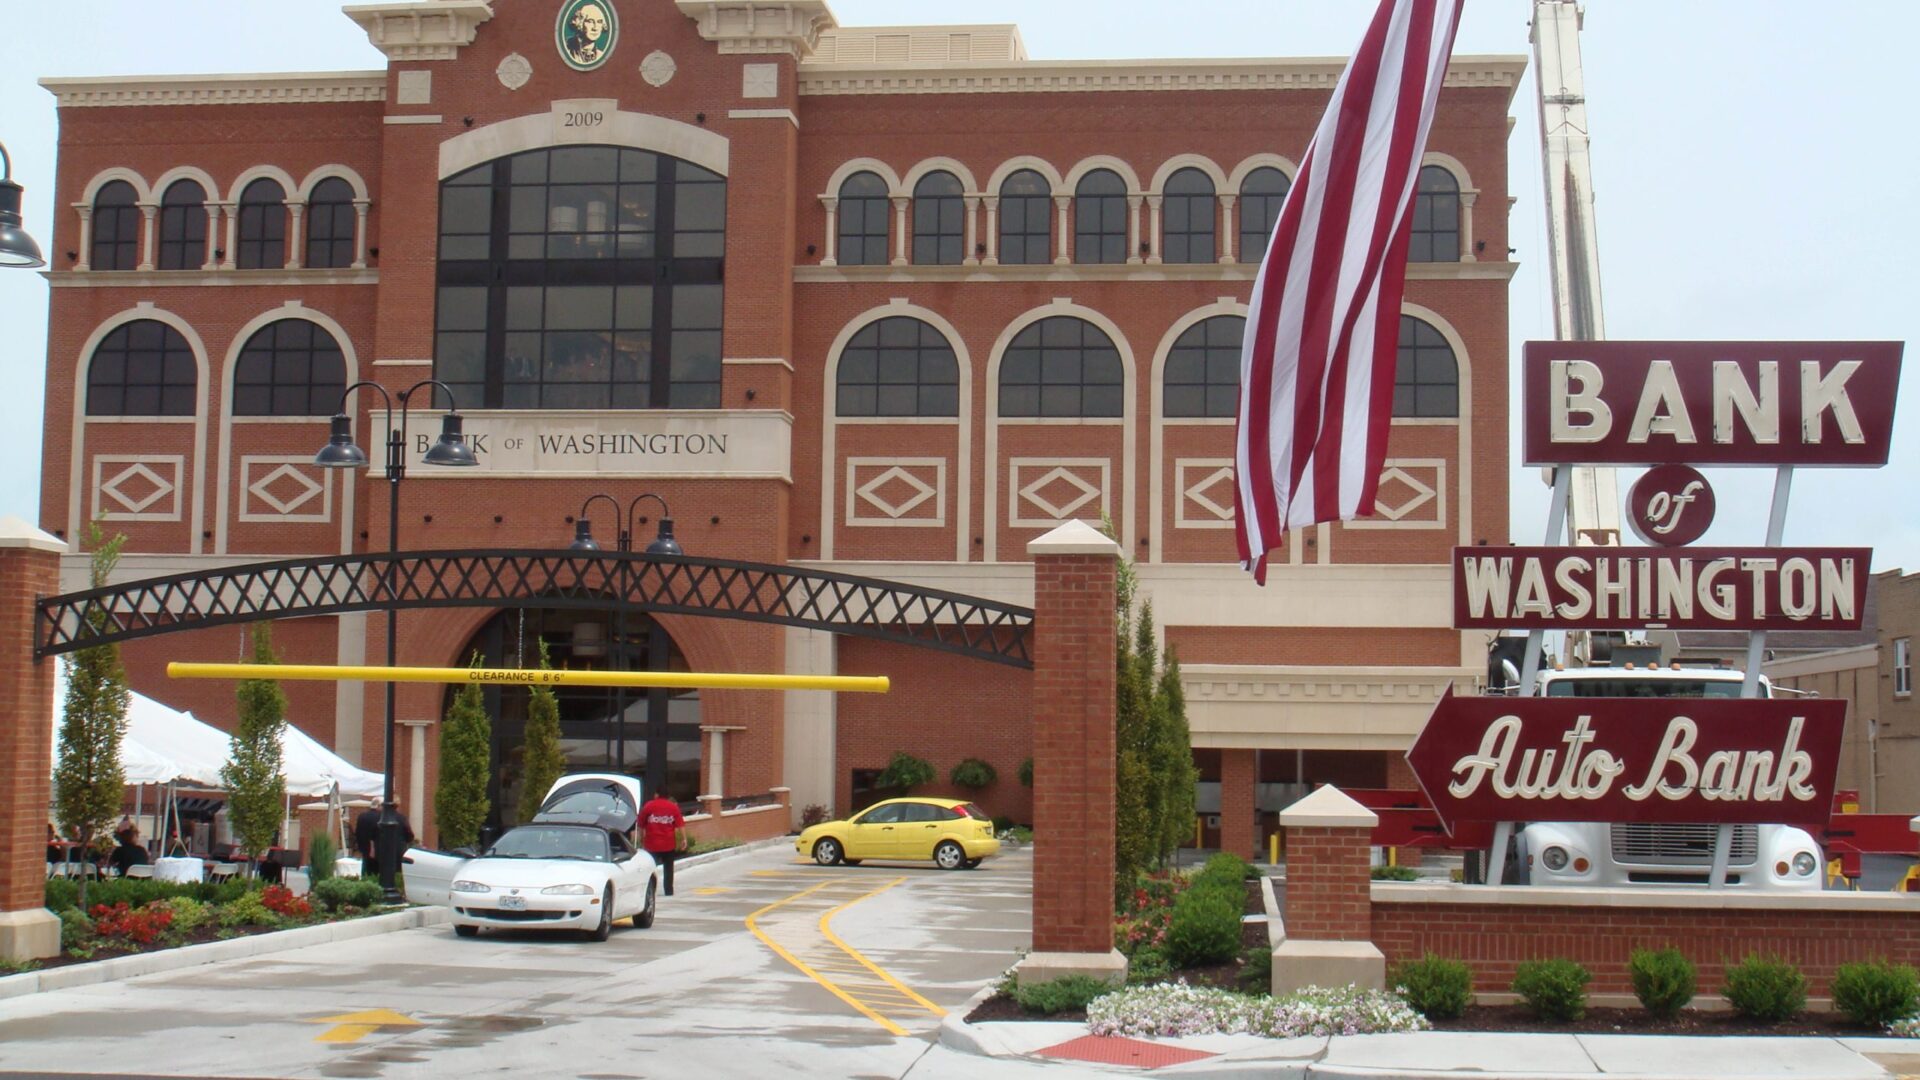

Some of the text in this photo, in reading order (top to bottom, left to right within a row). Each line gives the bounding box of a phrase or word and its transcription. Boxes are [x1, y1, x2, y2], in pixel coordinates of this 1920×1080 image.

[565, 111, 603, 127] 2009
[1550, 359, 1866, 445] BANK
[416, 433, 728, 455] BK OF WASHINGTON
[1645, 480, 1704, 535] of
[1463, 556, 1856, 621] WASHINGTON
[469, 671, 535, 682] CLEARANCE
[1448, 715, 1818, 803] Auto Bank
